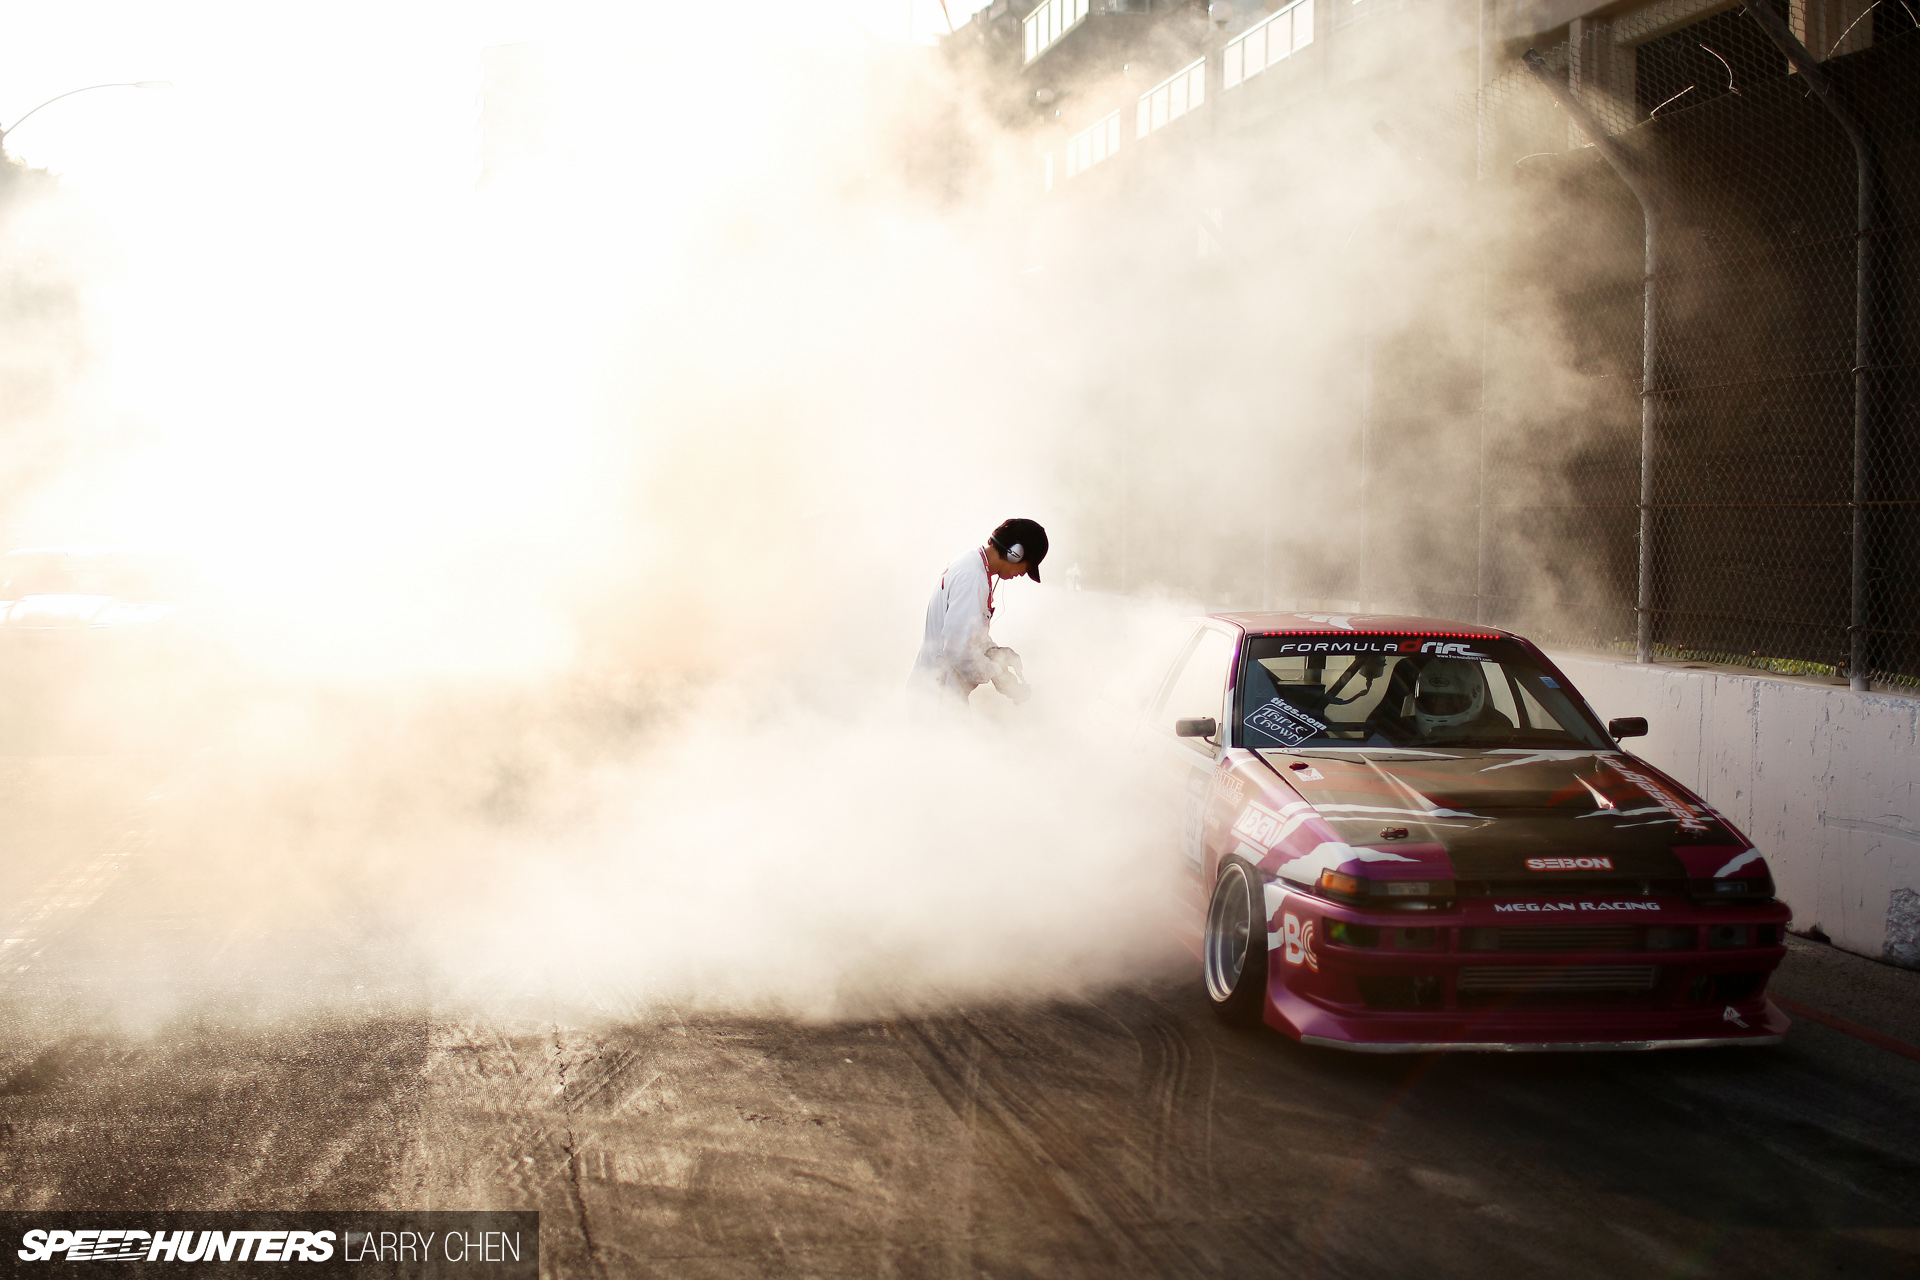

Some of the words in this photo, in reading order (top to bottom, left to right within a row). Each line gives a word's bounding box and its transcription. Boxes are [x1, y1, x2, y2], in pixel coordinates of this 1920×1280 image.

[1280, 642, 1398, 653] FORMULA
[1253, 713, 1304, 743] CROWN
[1262, 707, 1308, 735] TRIPLE
[1270, 697, 1327, 731] tires.com
[1213, 766, 1243, 792] BATTLE
[1593, 753, 1709, 830] hasselgren
[1526, 857, 1613, 870] SEBON
[1494, 902, 1576, 912] MEGAN
[1580, 901, 1661, 911] RACING
[1284, 912, 1318, 972] BC
